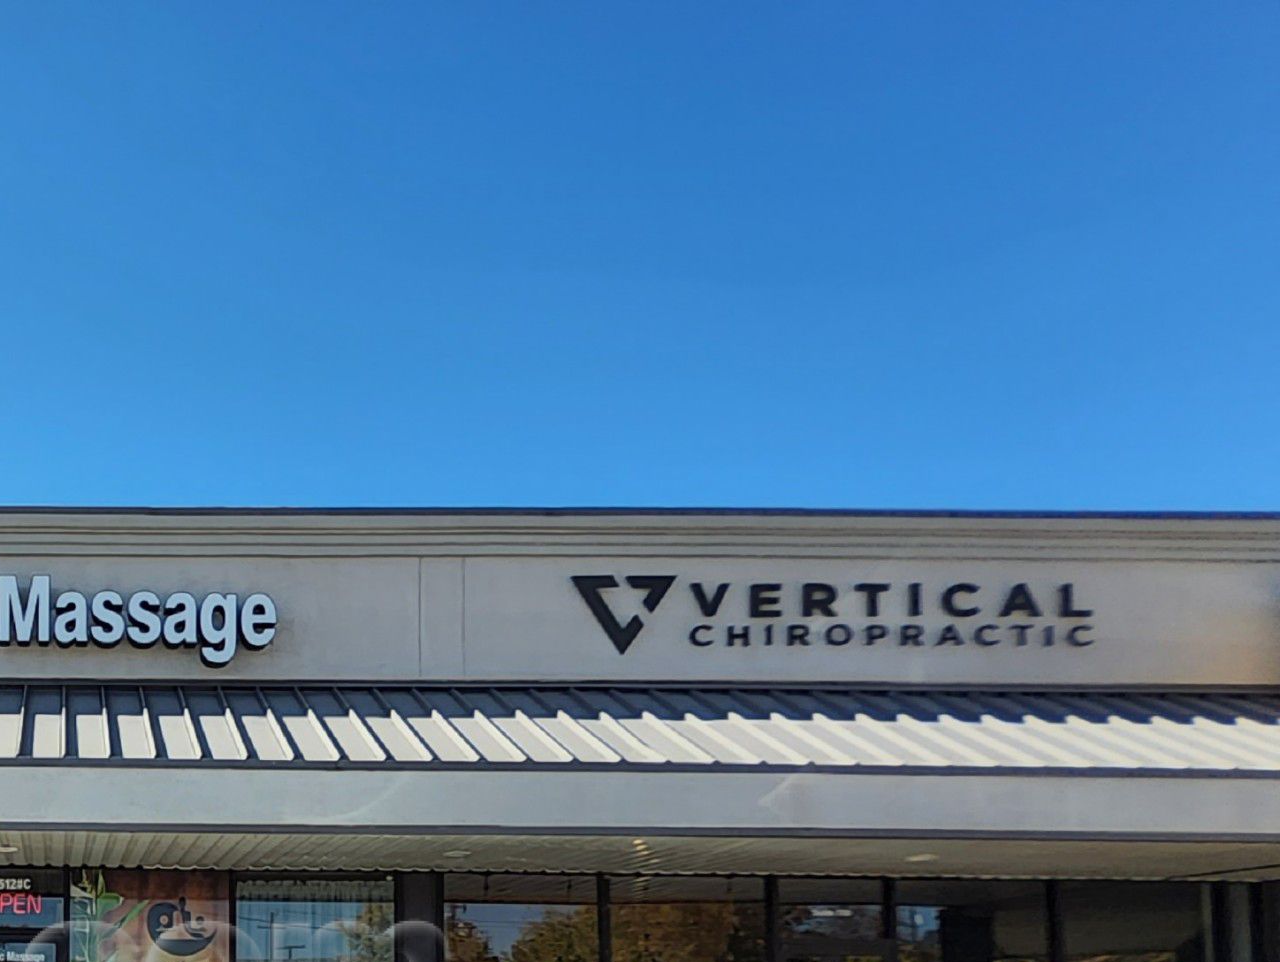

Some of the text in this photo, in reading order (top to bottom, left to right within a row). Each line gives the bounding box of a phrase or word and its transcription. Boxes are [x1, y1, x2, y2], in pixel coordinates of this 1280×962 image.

[689, 582, 1094, 618] VERTICAL
[688, 624, 1095, 647] CHIROPRACTIC
[6, 951, 45, 962] Massage
